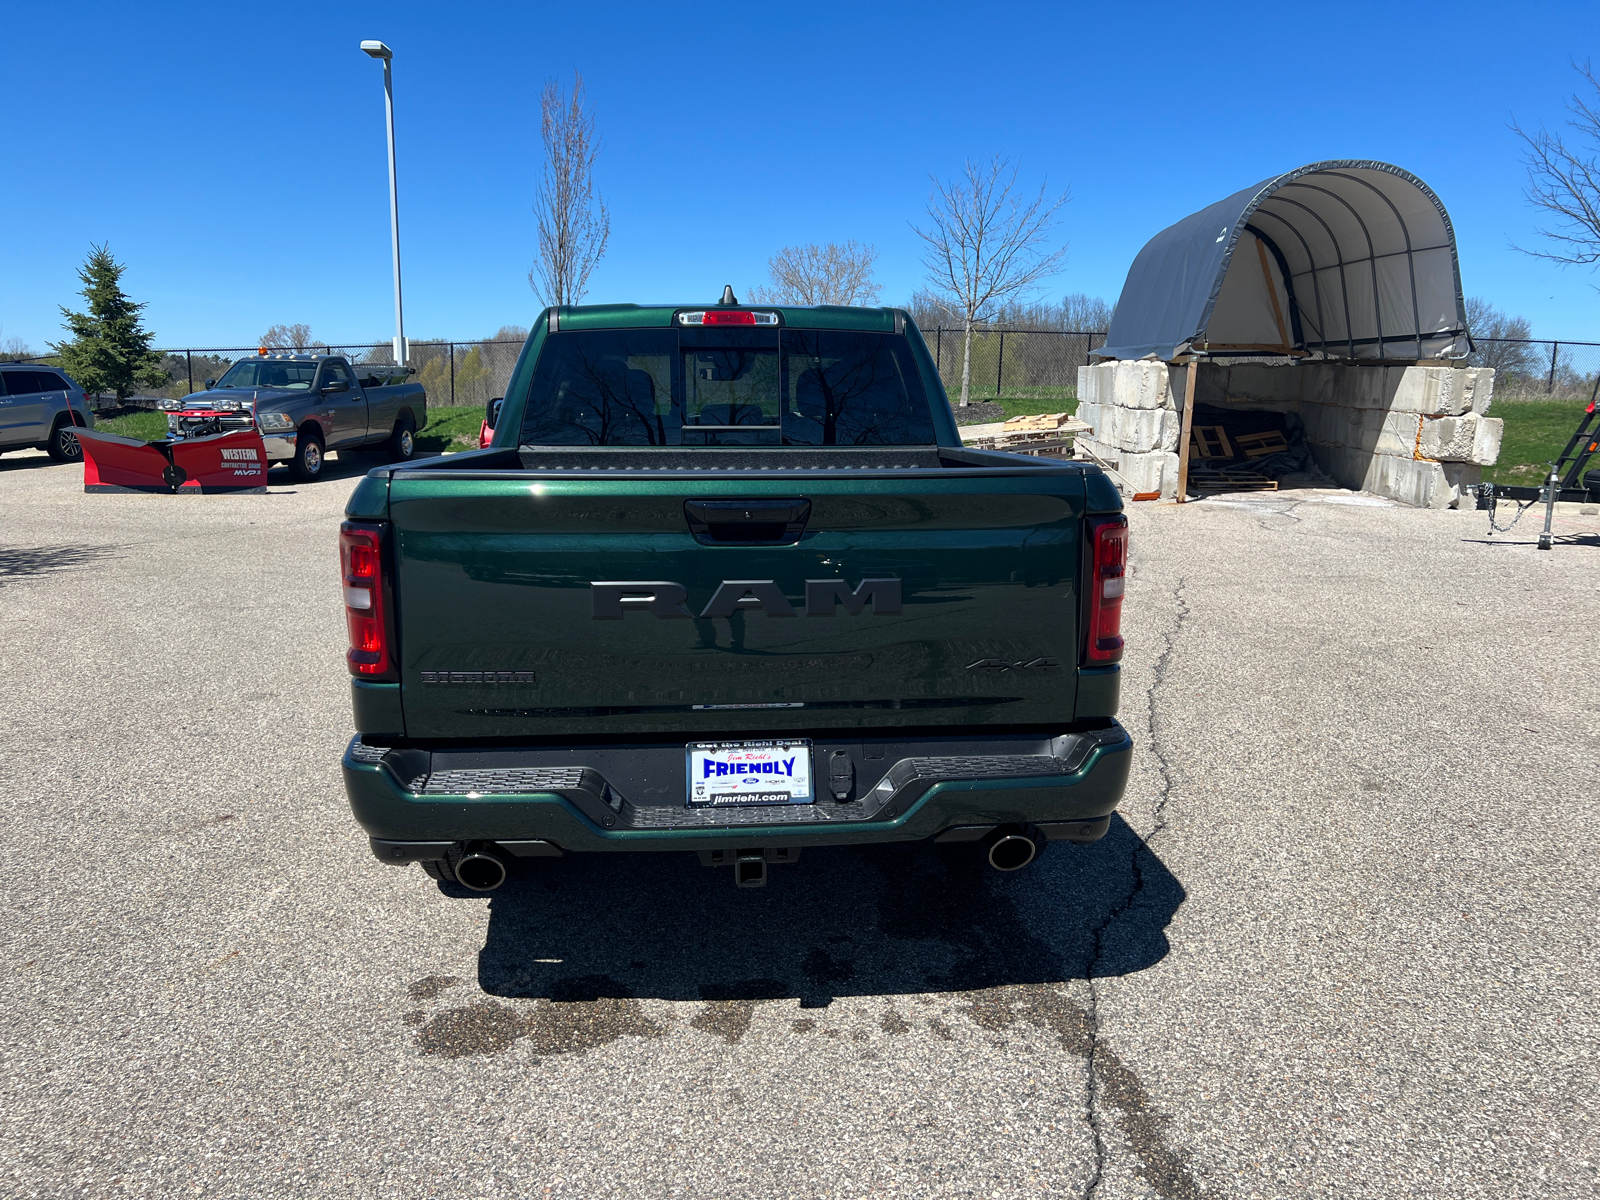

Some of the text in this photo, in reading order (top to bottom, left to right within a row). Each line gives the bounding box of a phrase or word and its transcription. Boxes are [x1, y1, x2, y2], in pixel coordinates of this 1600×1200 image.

[220, 449, 258, 460] WESTERN
[590, 578, 903, 620] RAM
[727, 754, 743, 762] Jim
[703, 756, 796, 779] FRIENDLY
[713, 794, 788, 805] jimriehl.com
